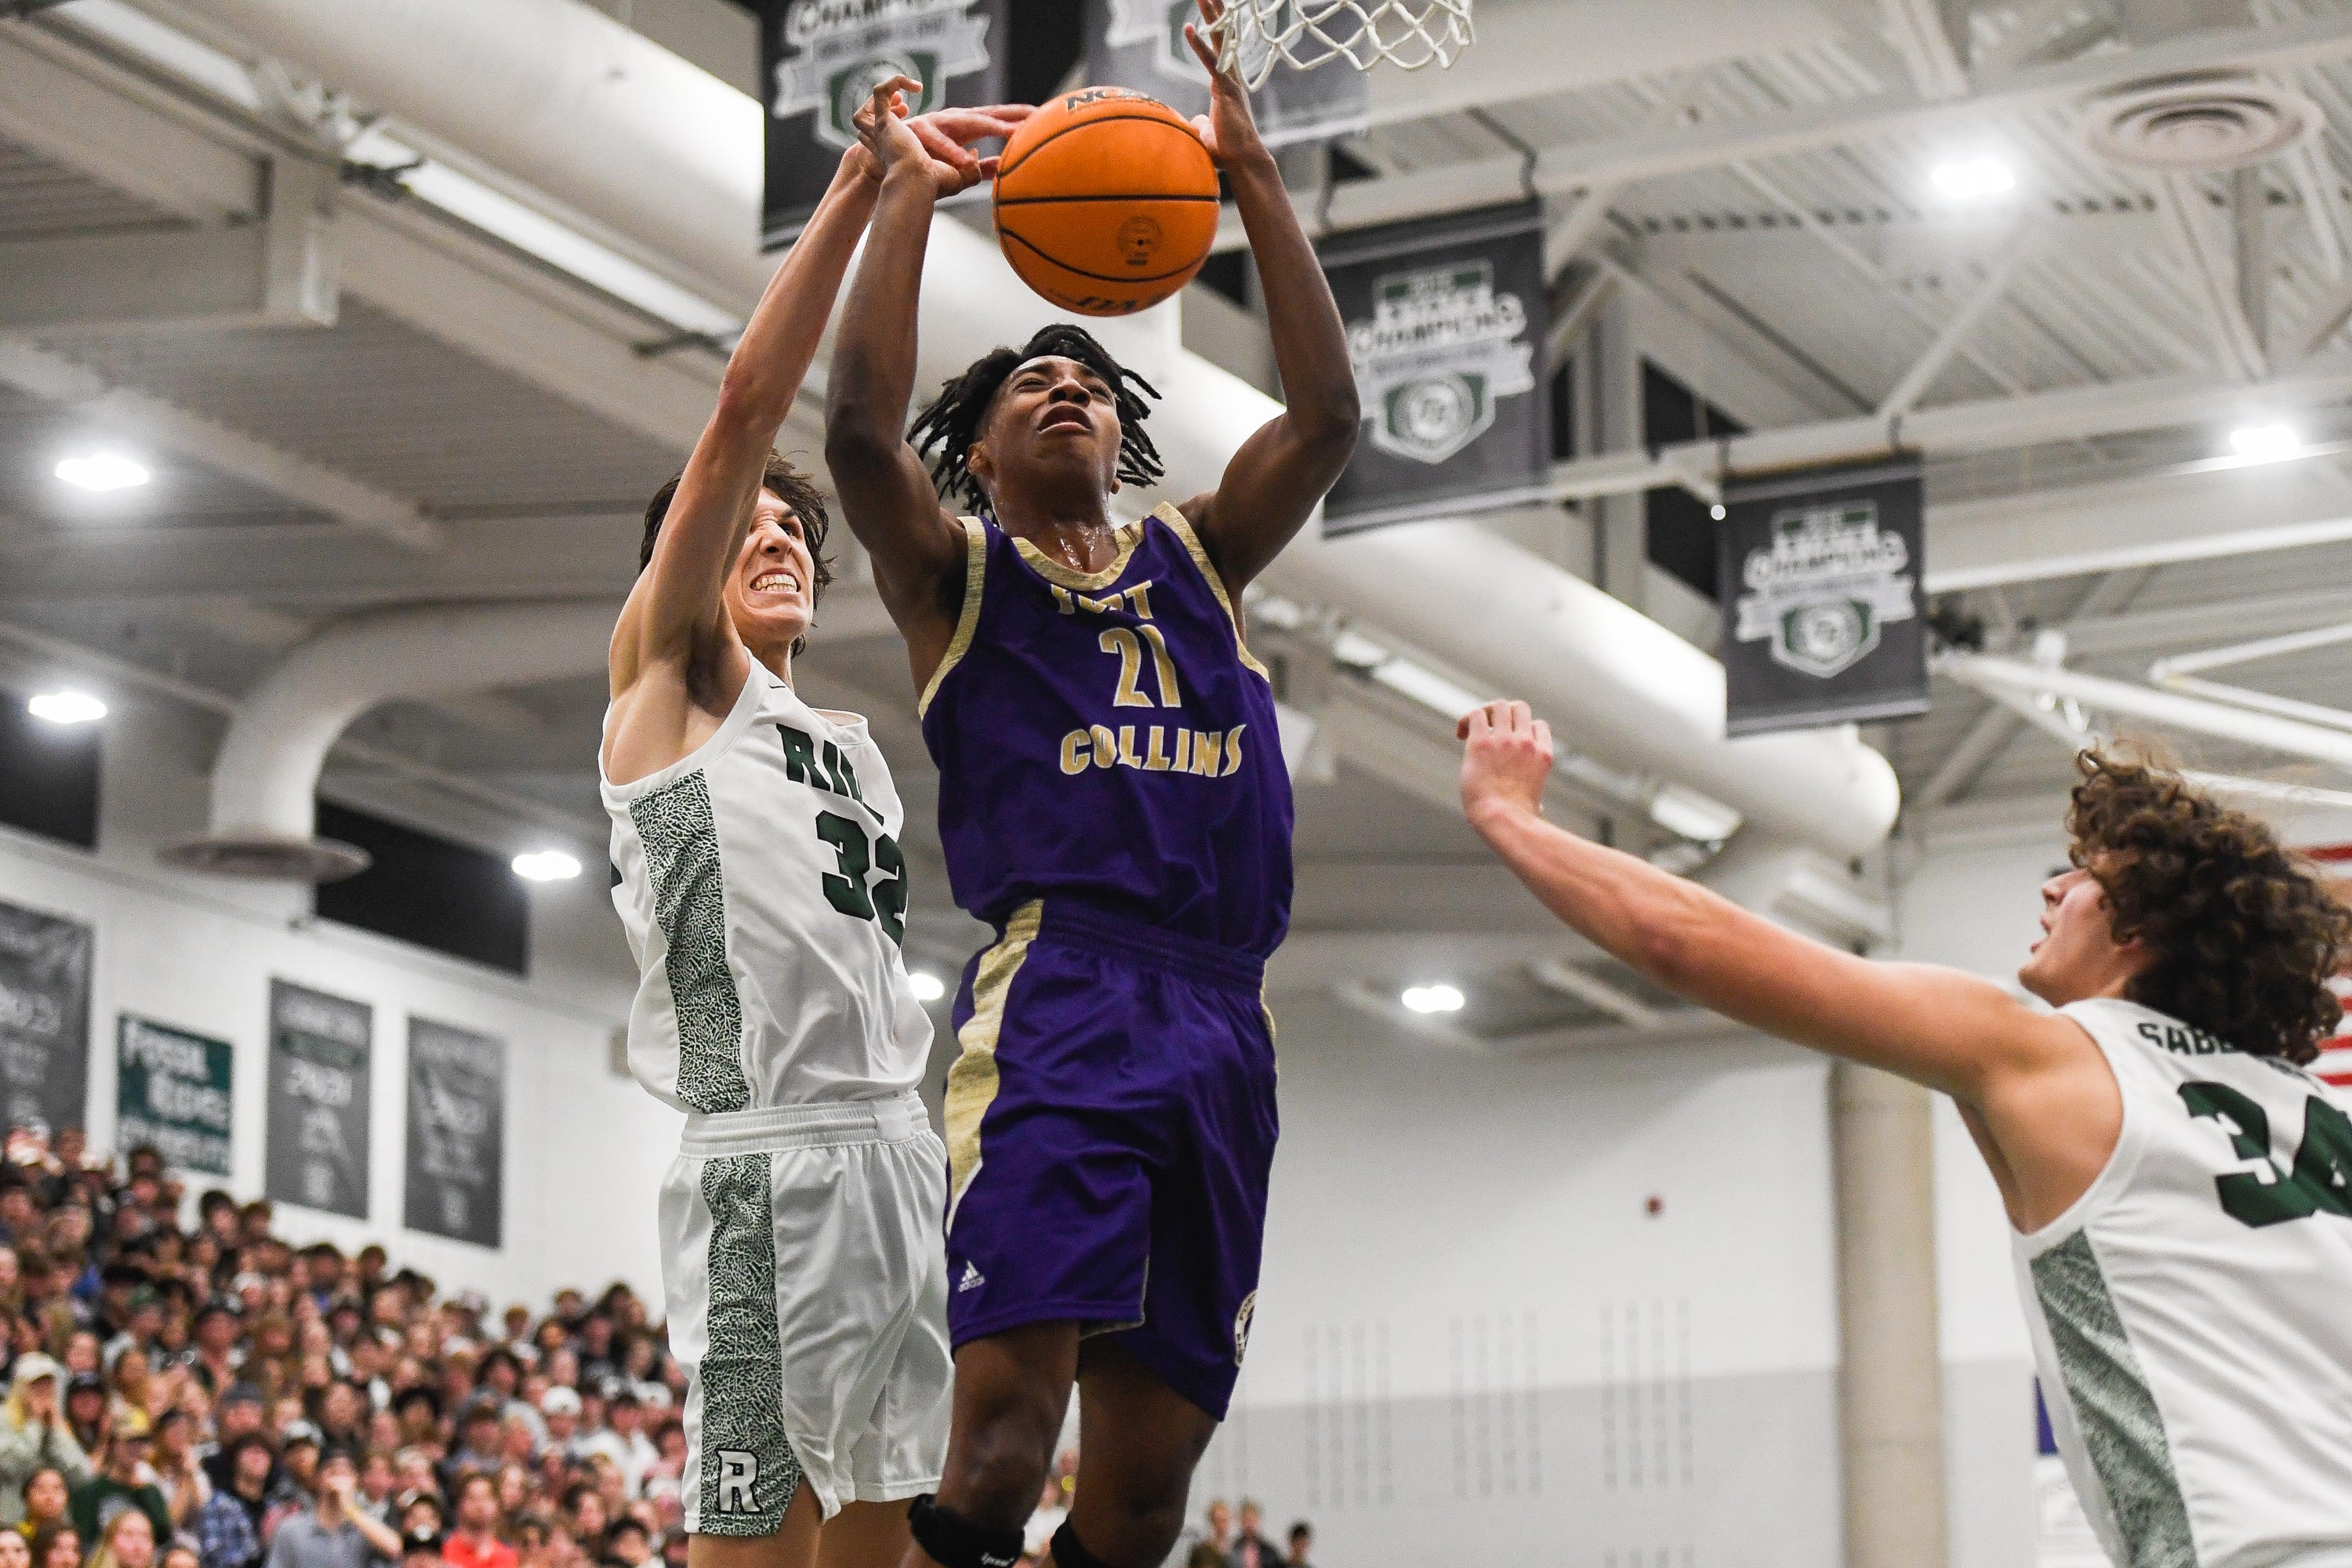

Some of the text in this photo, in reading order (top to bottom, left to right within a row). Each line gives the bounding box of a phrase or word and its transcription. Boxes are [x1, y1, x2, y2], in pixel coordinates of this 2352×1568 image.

[1098, 624, 1182, 708] 21
[1060, 724, 1247, 778] COLLINS
[815, 809, 908, 950] 32
[2176, 1080, 2352, 1229] 34
[714, 1447, 763, 1514] R
